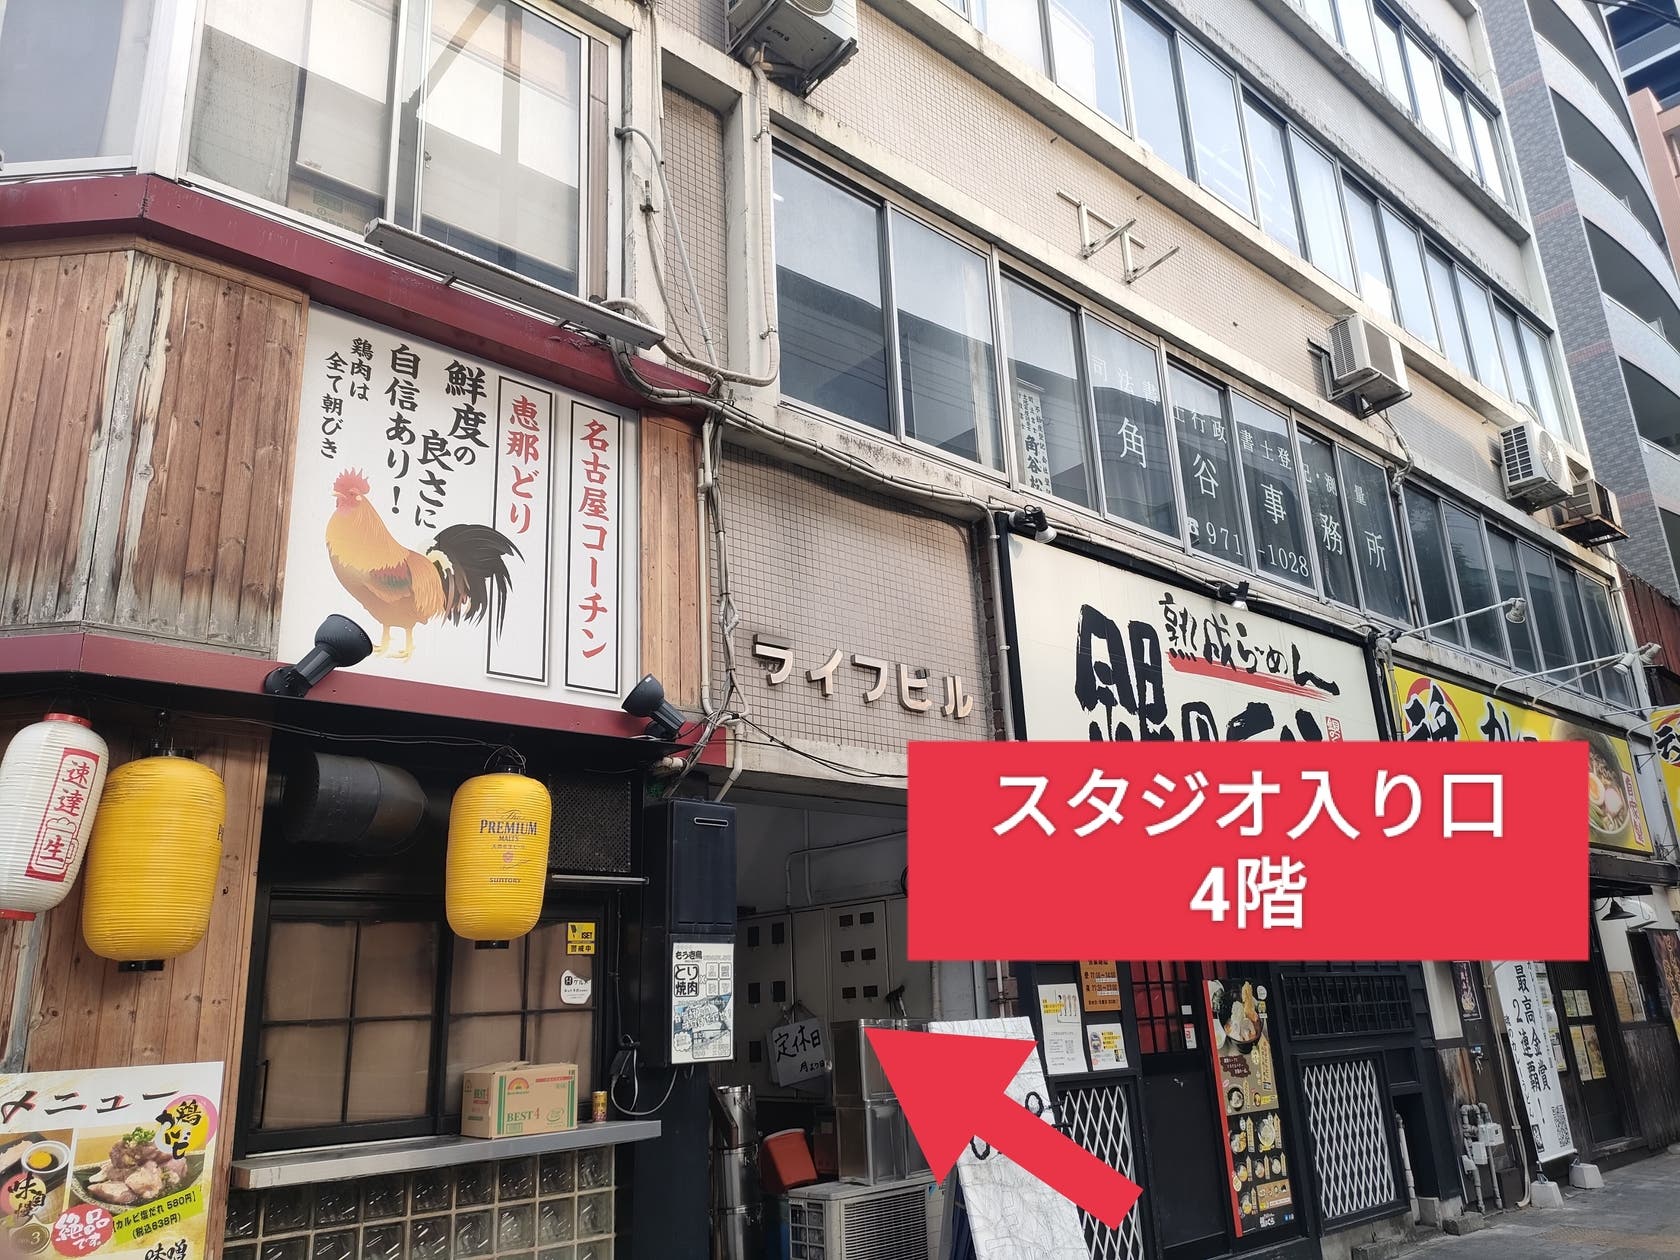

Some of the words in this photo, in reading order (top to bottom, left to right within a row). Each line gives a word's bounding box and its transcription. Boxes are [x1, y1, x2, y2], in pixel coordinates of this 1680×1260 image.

[320, 352, 348, 459] 全て朝びき
[349, 337, 374, 402] 鶏肉は
[444, 360, 489, 466] 鮮度の
[414, 429, 454, 529] 良さに
[506, 394, 540, 535] 恵那どり
[578, 419, 609, 659] 名古屋コーチン
[753, 634, 974, 720] ライフビル
[480, 819, 538, 836] PREMIUM
[675, 966, 698, 981] とり
[675, 981, 698, 996] 焼肉
[775, 1025, 821, 1062] 定休日
